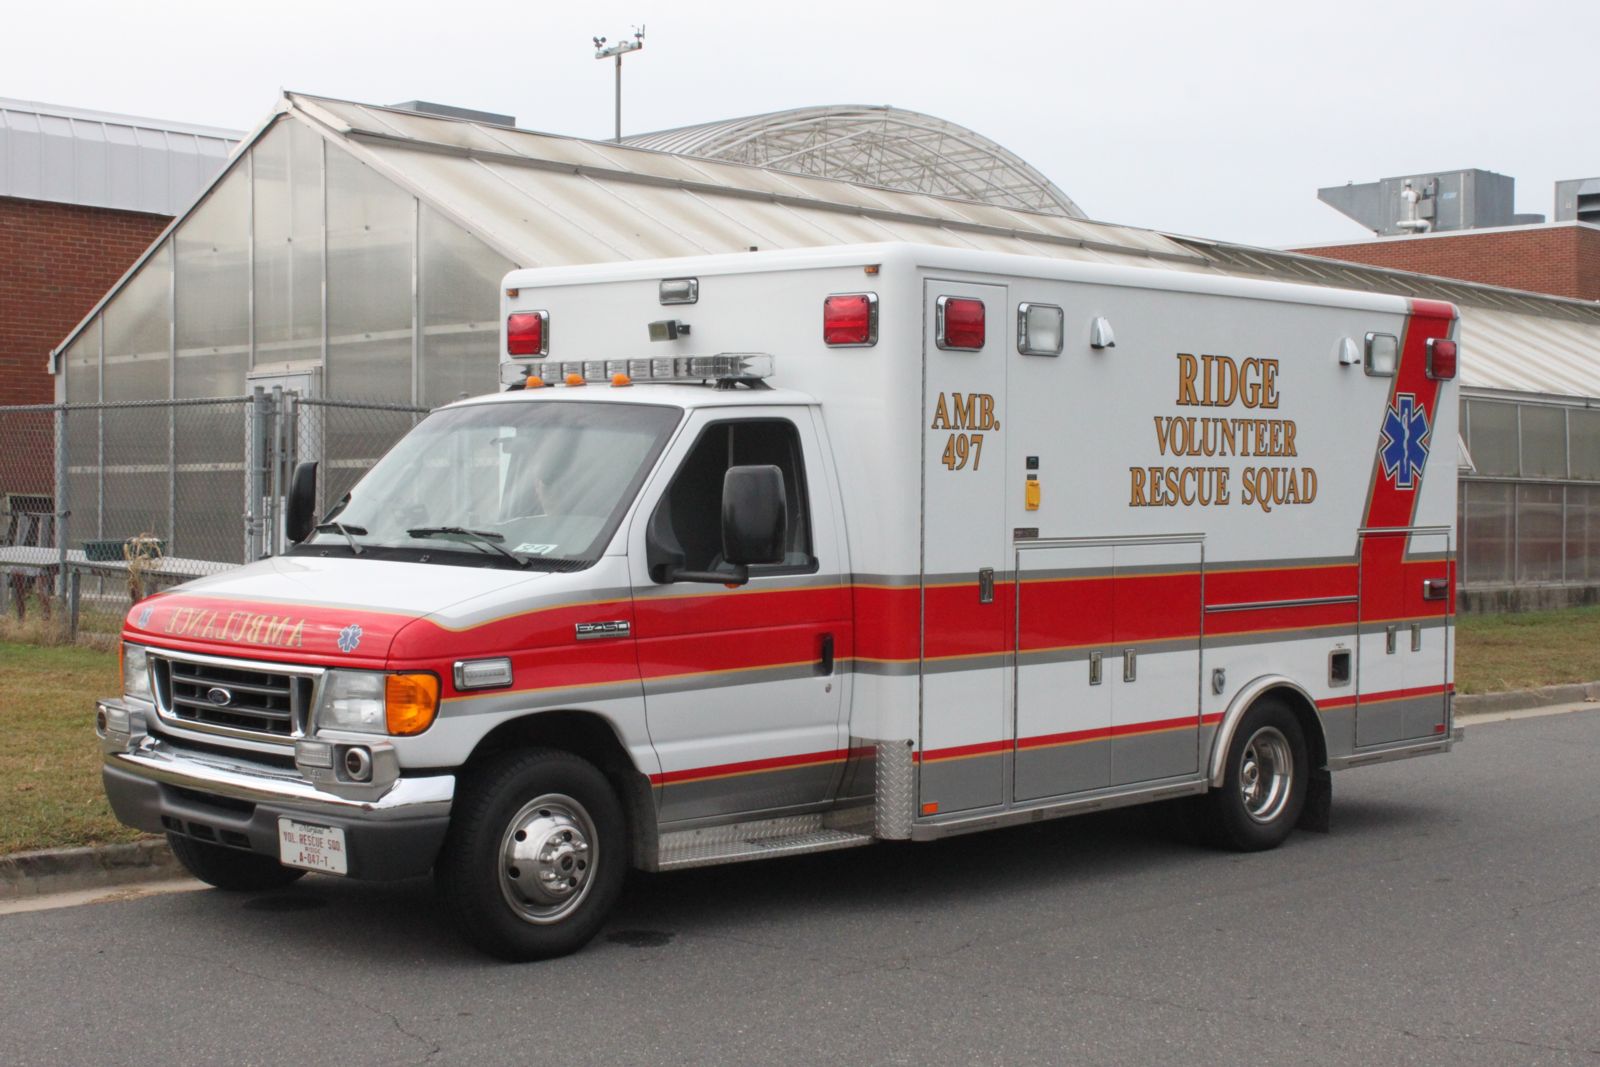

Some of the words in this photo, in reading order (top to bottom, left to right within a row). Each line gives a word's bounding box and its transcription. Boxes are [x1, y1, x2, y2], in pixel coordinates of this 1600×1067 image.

[1176, 353, 1280, 409] RIDGE
[931, 392, 1000, 431] AMB.
[942, 433, 984, 471] 497
[1154, 416, 1298, 457] VOLUNTEER
[1129, 467, 1231, 507] RESCUE
[1241, 467, 1319, 513] SQUAD
